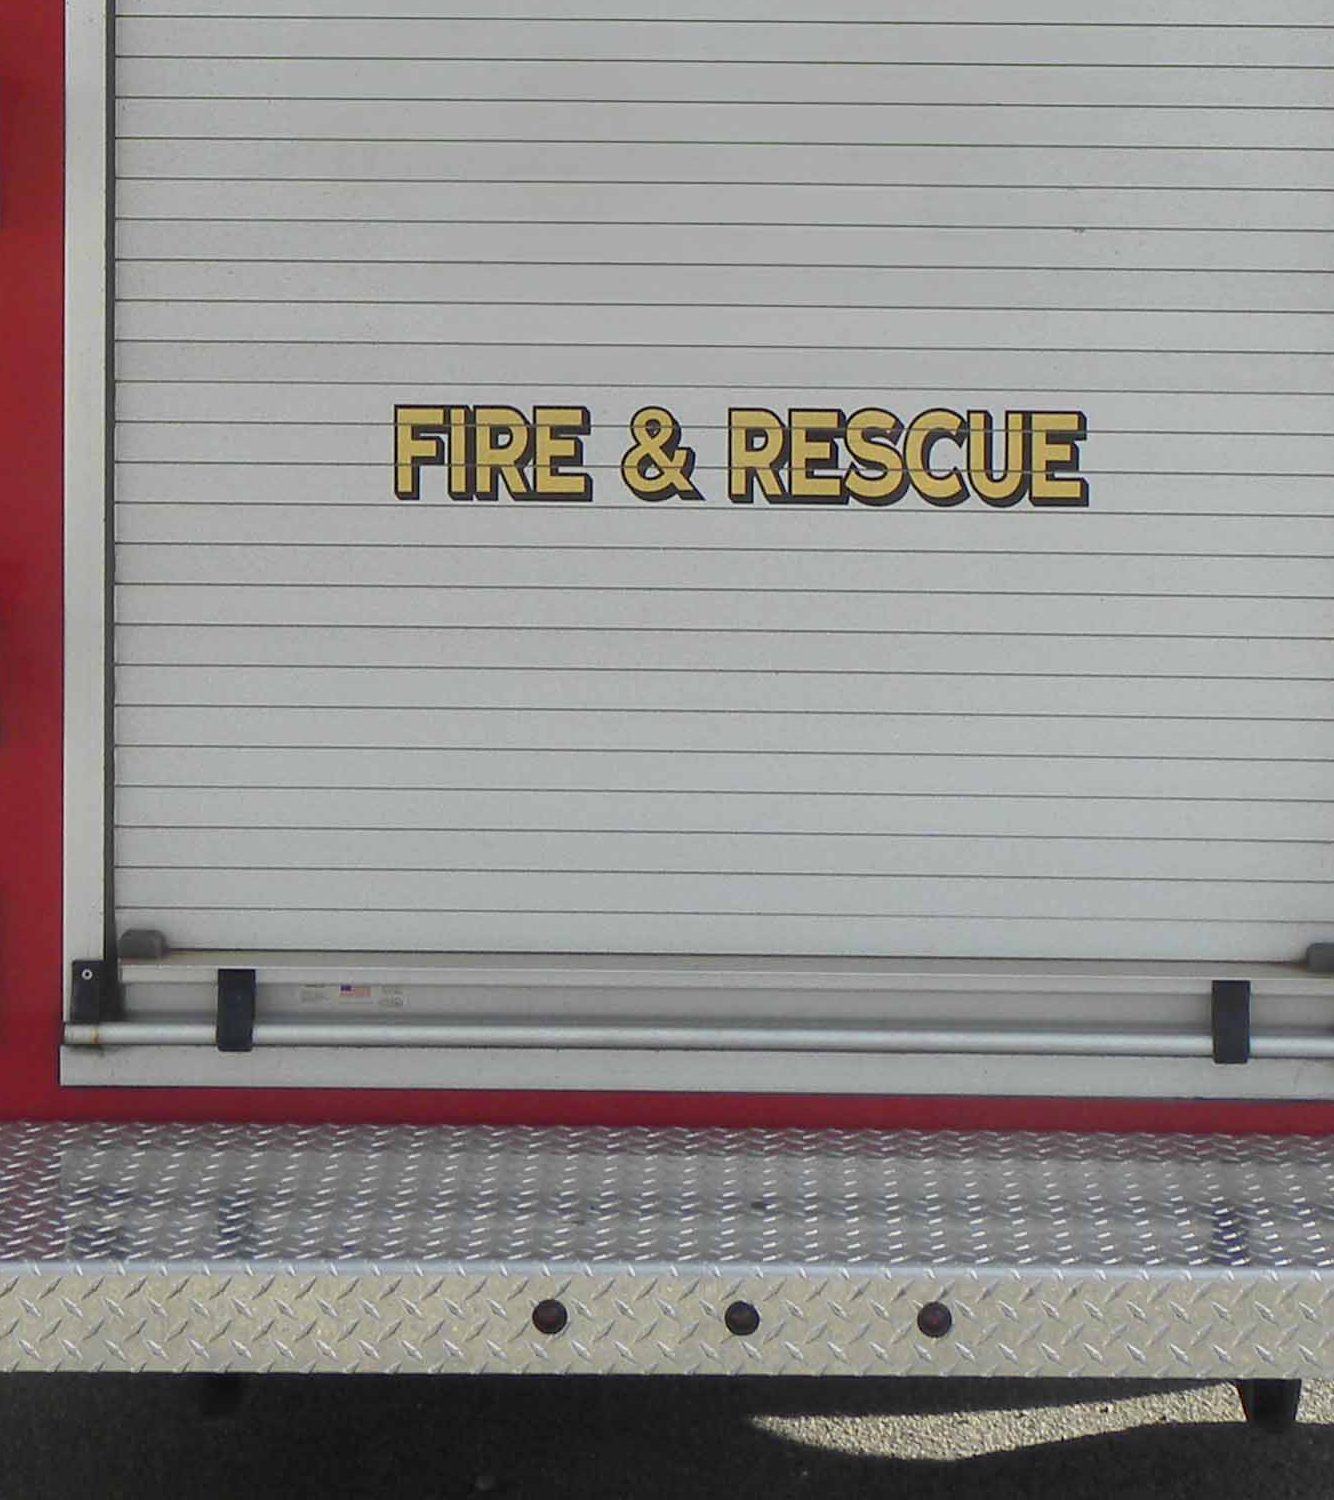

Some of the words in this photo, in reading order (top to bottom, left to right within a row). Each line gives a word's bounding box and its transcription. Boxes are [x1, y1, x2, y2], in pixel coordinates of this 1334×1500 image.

[393, 404, 593, 503] FIRE
[620, 406, 705, 503] &
[727, 407, 1089, 507] RESCUE
